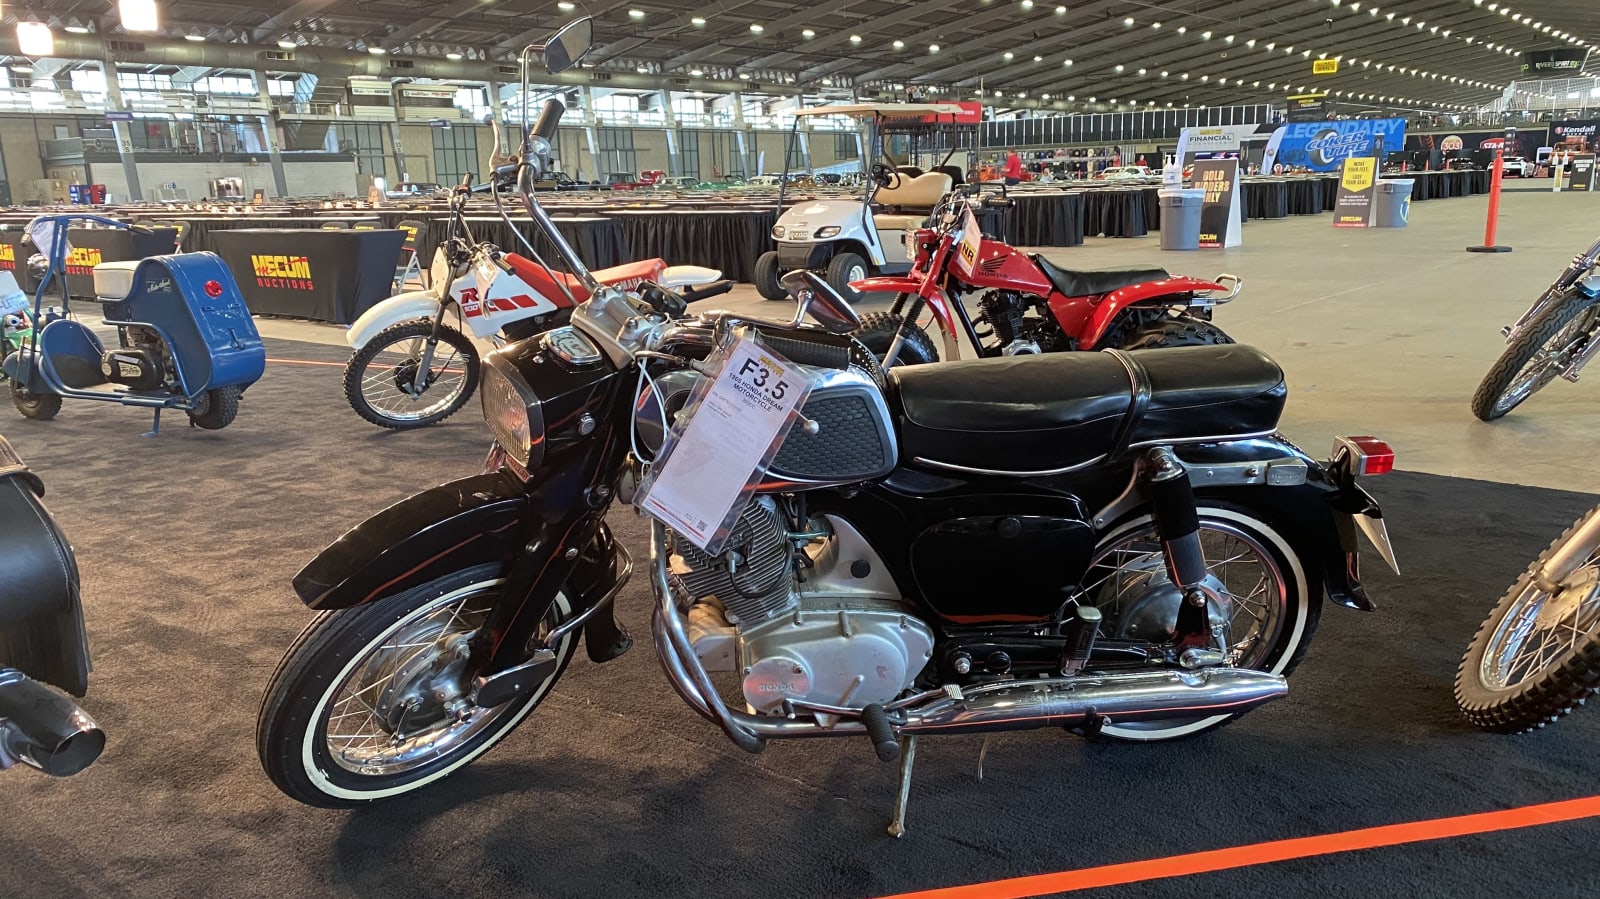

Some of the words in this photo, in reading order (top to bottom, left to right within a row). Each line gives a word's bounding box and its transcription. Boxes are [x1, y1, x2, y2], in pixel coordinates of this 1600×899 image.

[1283, 118, 1401, 139] LEGENDARY
[1563, 125, 1596, 133] Kendall
[1190, 134, 1232, 142] FINANCIAL
[1305, 131, 1366, 152] COKER
[1325, 140, 1369, 157] TIRE
[1203, 192, 1221, 203] NLY
[962, 242, 974, 260] NR
[251, 255, 311, 279] MECUM
[978, 271, 1008, 279] HONDA
[257, 278, 315, 291] AUCTIONS
[464, 304, 478, 312] 100
[739, 358, 789, 400] F3.5
[733, 383, 772, 412] MOTORCYCLE
[741, 381, 762, 398] HONDA
[762, 394, 783, 412] DREAM
[759, 683, 795, 692] HONDA
